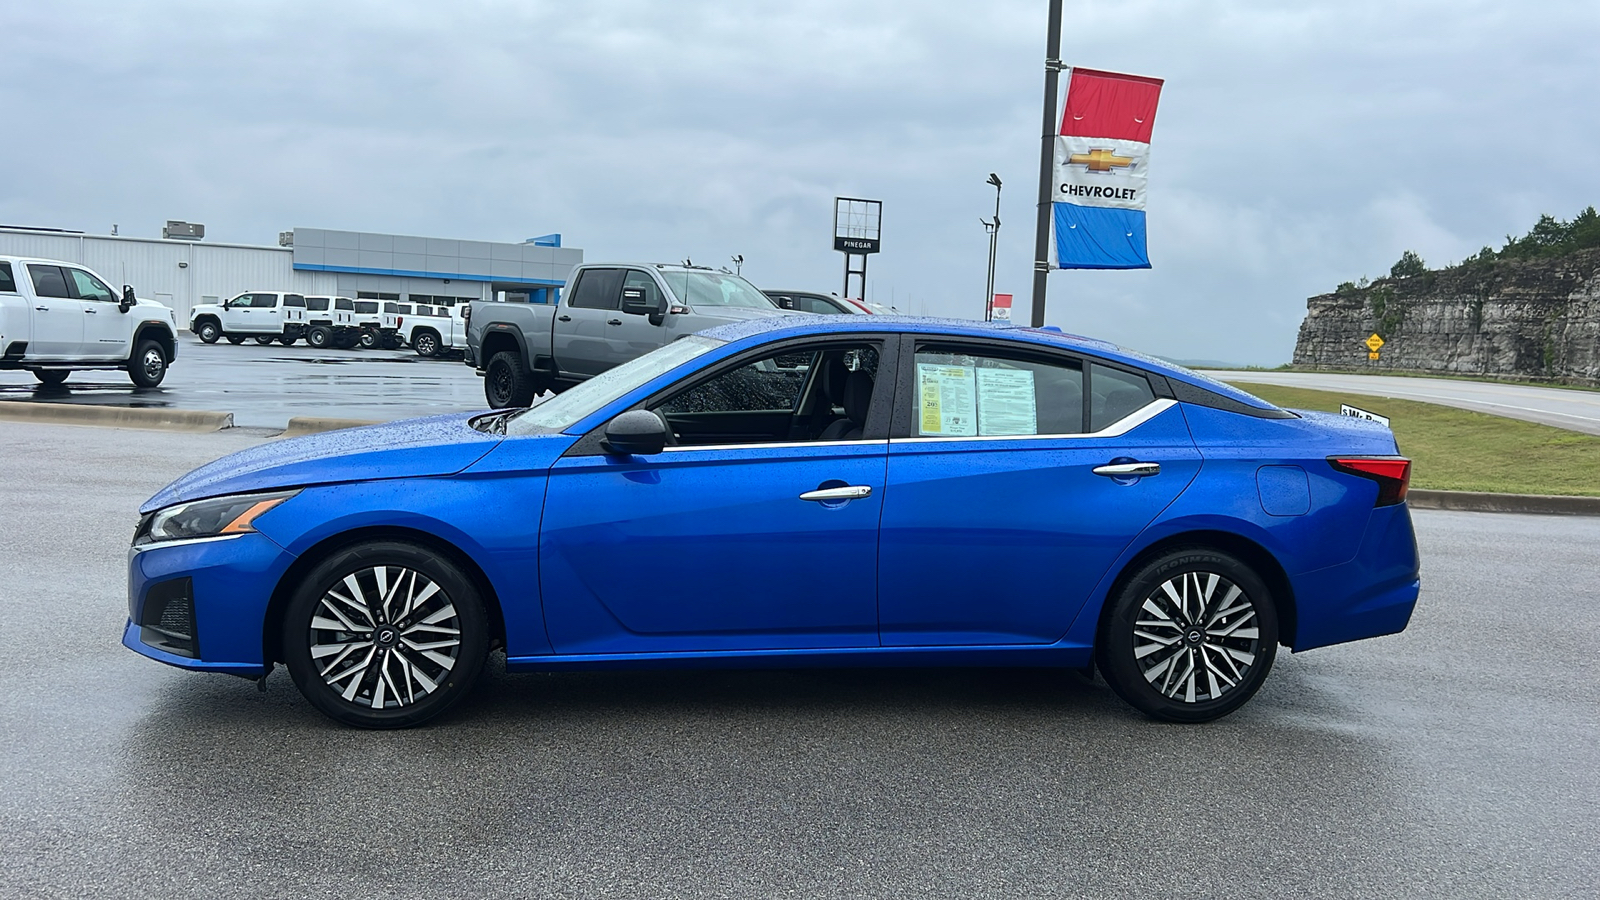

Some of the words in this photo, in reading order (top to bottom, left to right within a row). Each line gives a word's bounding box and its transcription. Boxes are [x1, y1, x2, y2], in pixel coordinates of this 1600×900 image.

[1060, 183, 1136, 200] CHEVROLET
[844, 241, 872, 249] PINEGAR
[1156, 556, 1221, 575] IRONMAN
